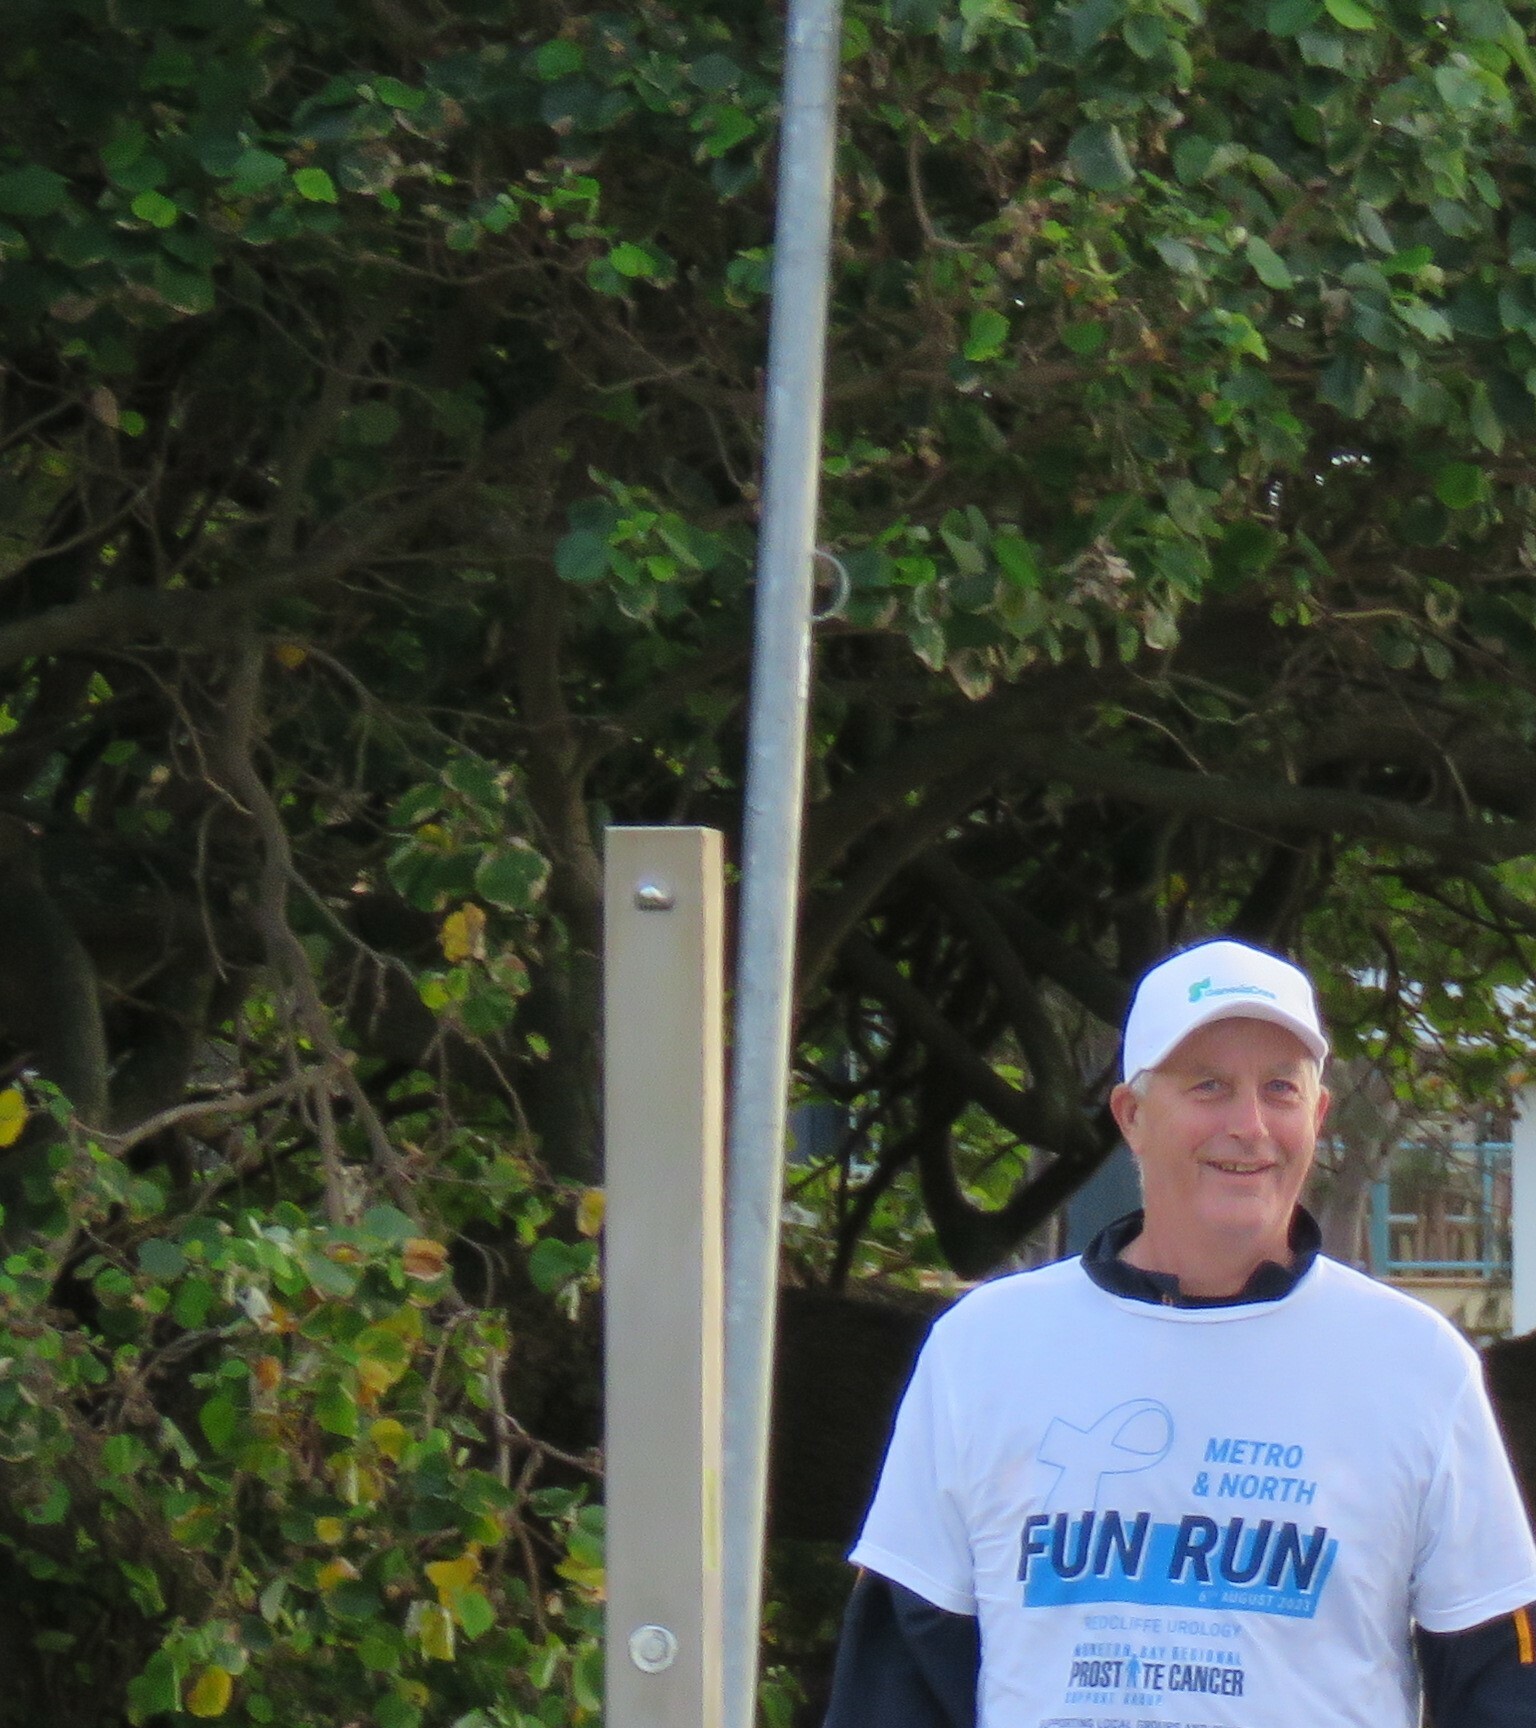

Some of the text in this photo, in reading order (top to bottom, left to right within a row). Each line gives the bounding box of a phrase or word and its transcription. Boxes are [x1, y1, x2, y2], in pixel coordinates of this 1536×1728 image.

[1204, 1437, 1303, 1469] METRO
[1192, 1472, 1318, 1506] & NORTH
[1016, 1510, 1328, 1591] FUN RUN
[1168, 1664, 1244, 1696] CANCER
